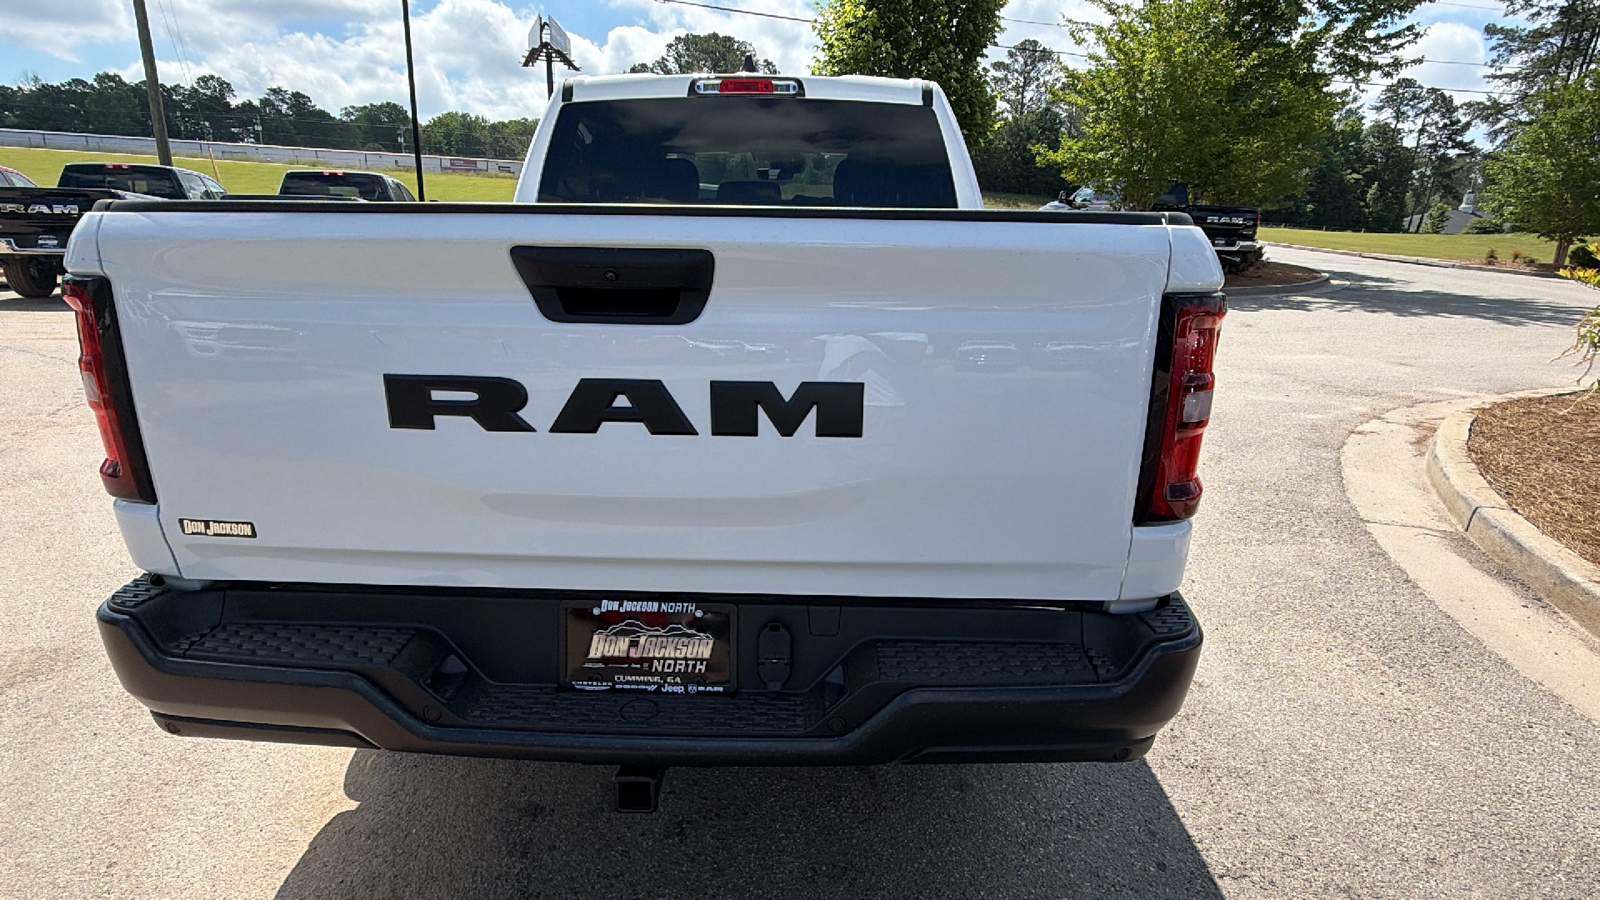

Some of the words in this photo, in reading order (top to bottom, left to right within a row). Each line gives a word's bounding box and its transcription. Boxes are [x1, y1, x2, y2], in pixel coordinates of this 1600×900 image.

[0, 203, 79, 213] RAM
[383, 374, 865, 437] RAM
[660, 603, 696, 613] NORTH
[651, 659, 707, 673] NORTH
[614, 675, 664, 684] CUMMING,
[666, 676, 682, 684] GA
[661, 684, 685, 693] Jeep
